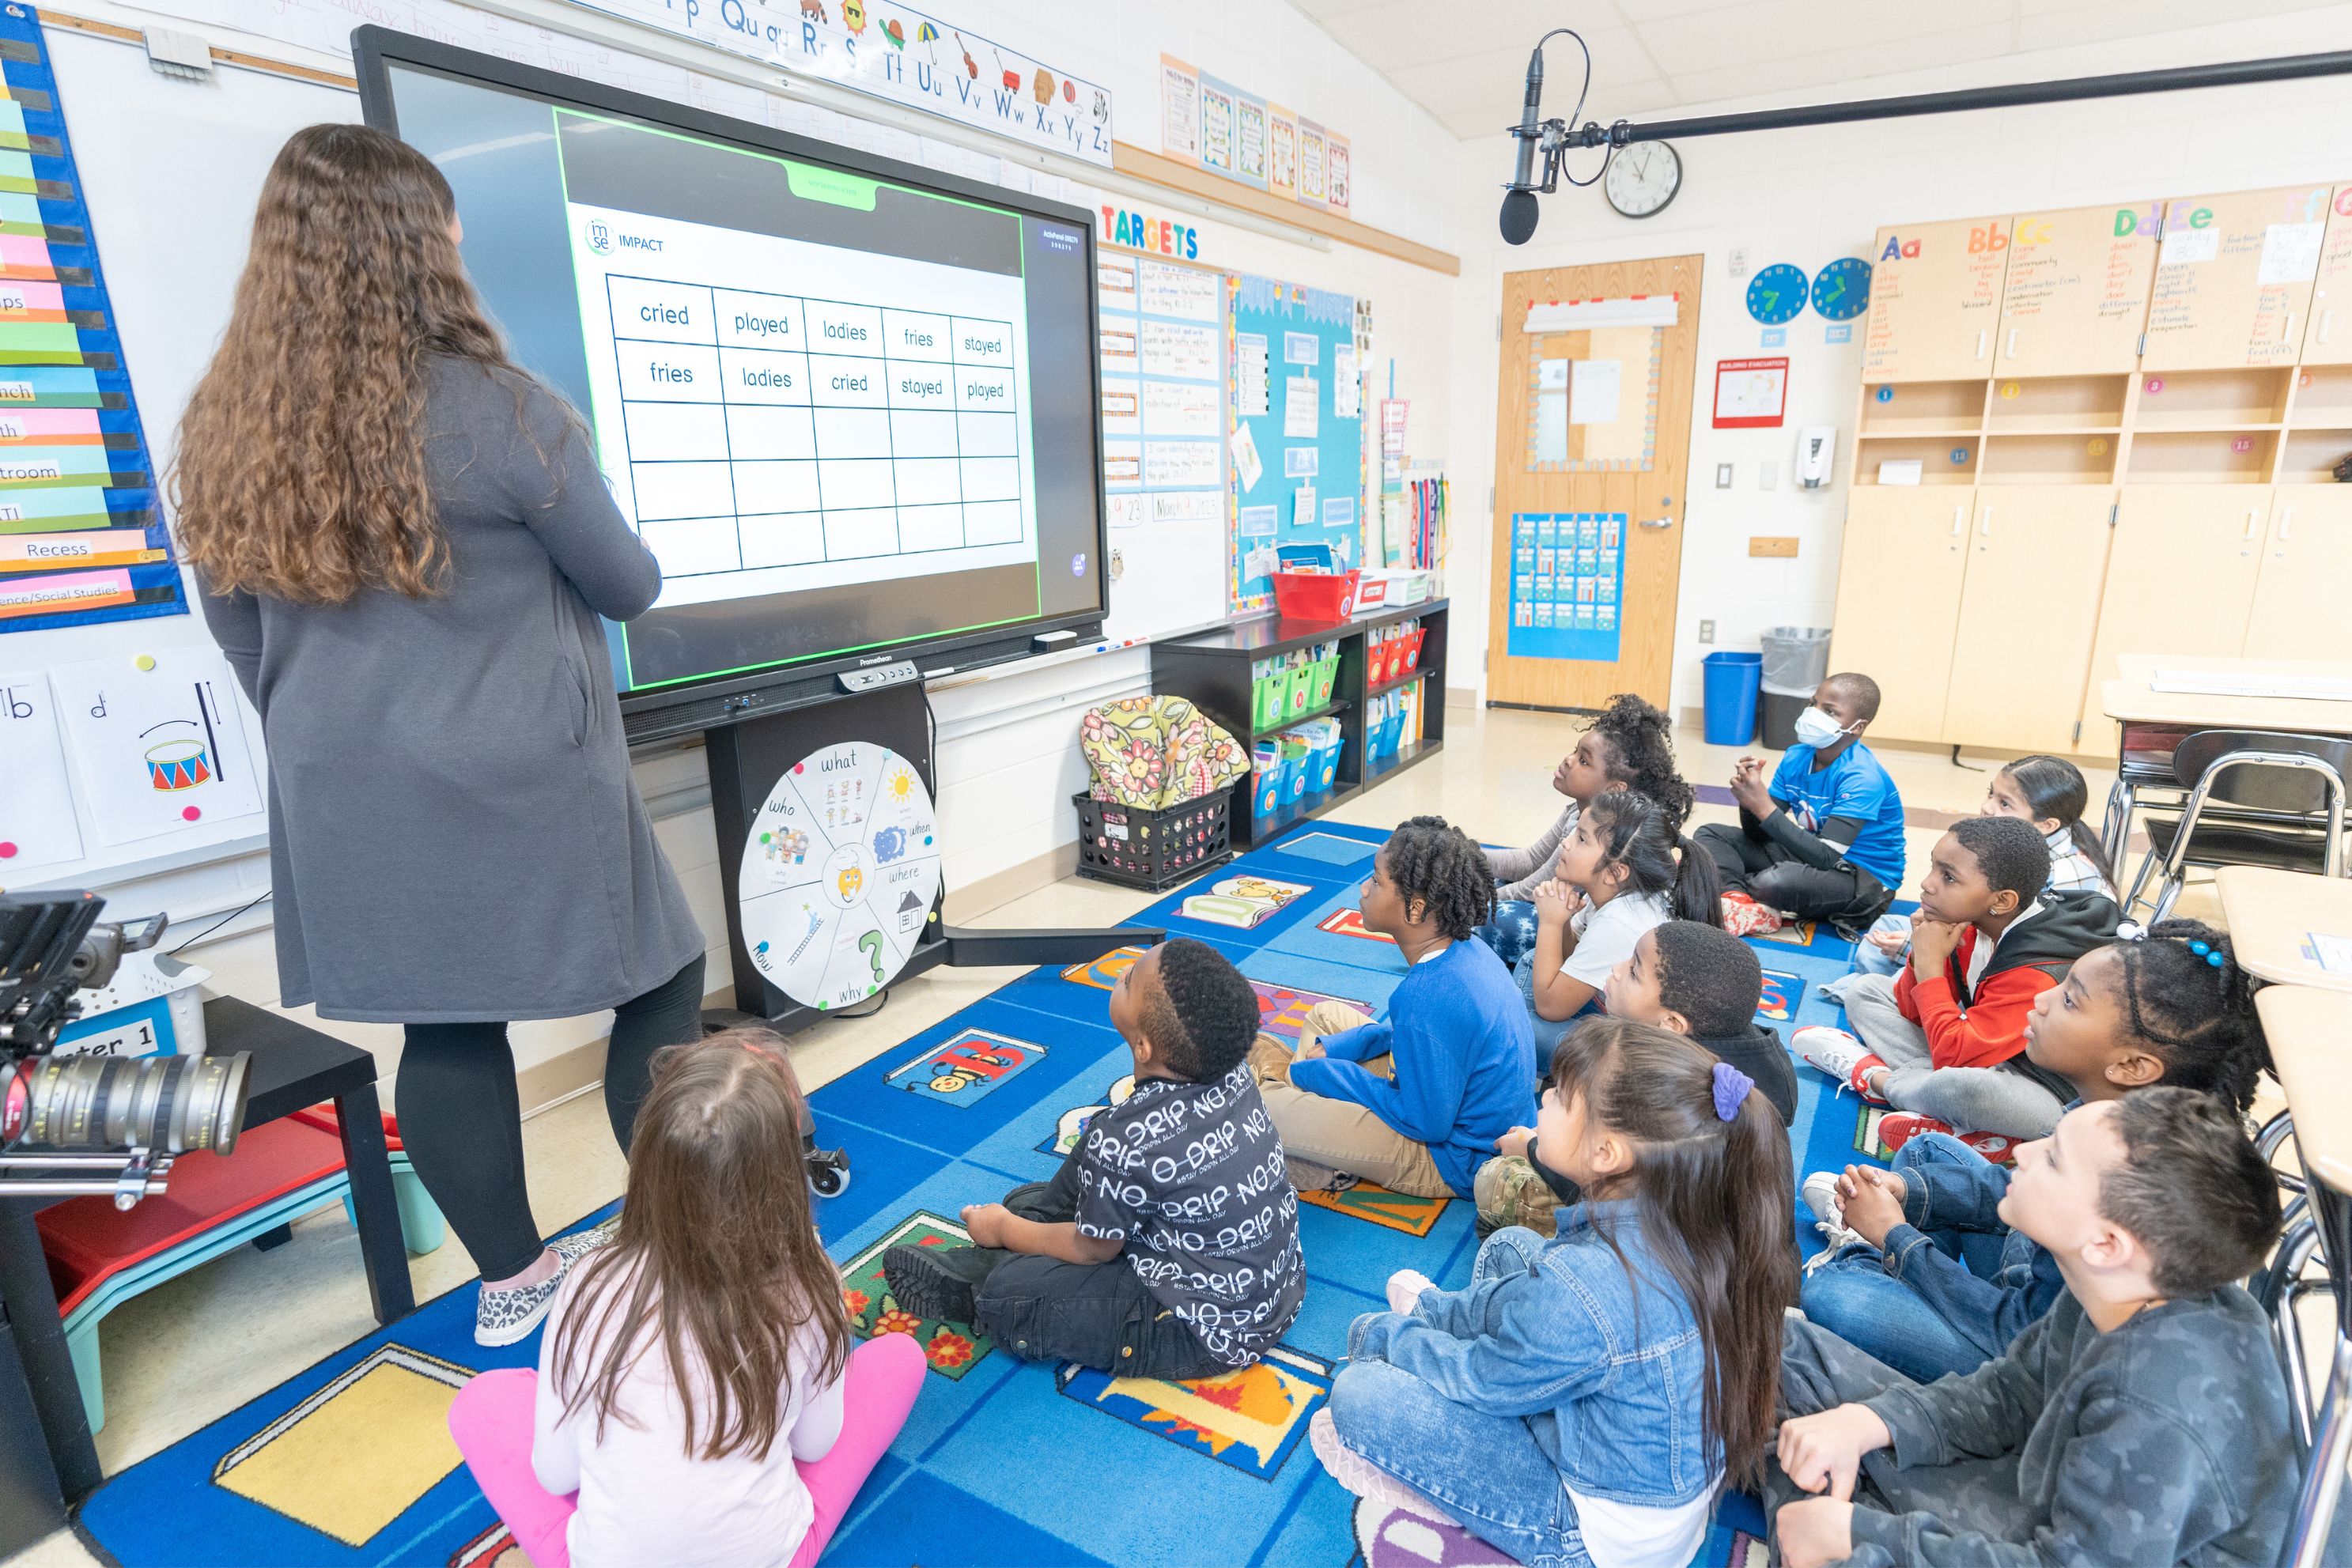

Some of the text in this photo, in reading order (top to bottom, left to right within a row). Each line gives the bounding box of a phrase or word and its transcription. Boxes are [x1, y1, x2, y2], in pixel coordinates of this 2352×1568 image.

[2170, 202, 2214, 231] Ee
[618, 235, 664, 251] IMPACT
[1102, 206, 1198, 259] TARGETS
[1968, 223, 2009, 254] Bb
[2017, 217, 2055, 244] Cc
[1881, 236, 1923, 262] Aa
[0, 297, 24, 311] ps
[640, 304, 1001, 356] cried played ladies fries stayed
[1748, 359, 1787, 368] EVACUATION
[650, 362, 1004, 400] fries ladies cried stayed played
[28, 544, 89, 557] Recess
[75, 586, 119, 599] Studies
[860, 655, 892, 667] Promethean
[8, 687, 33, 719] b
[91, 692, 108, 718] d
[821, 749, 857, 773] what
[769, 797, 796, 817] who
[909, 822, 931, 837] when
[889, 866, 920, 884] where
[838, 983, 863, 1004] why
[138, 1026, 153, 1046] 1
[1193, 1086, 1226, 1119] NO
[1163, 1132, 1175, 1143] ALL
[1177, 1123, 1189, 1135] DAY
[1242, 1108, 1266, 1143] NO
[1087, 1128, 1146, 1170] DRIP
[1186, 1120, 1236, 1169] DRIP
[1219, 1154, 1230, 1162] ALL
[1230, 1144, 1239, 1155] DAY
[1097, 1177, 1147, 1207] NO
[1237, 1165, 1269, 1205] NO
[1162, 1185, 1231, 1218] DRIP
[1161, 1206, 1275, 1252] NO DRIP
[1250, 1240, 1262, 1249] ALL
[1263, 1231, 1273, 1242] DAY
[1189, 1268, 1256, 1294] DRIP
[1176, 1302, 1221, 1326] NO
